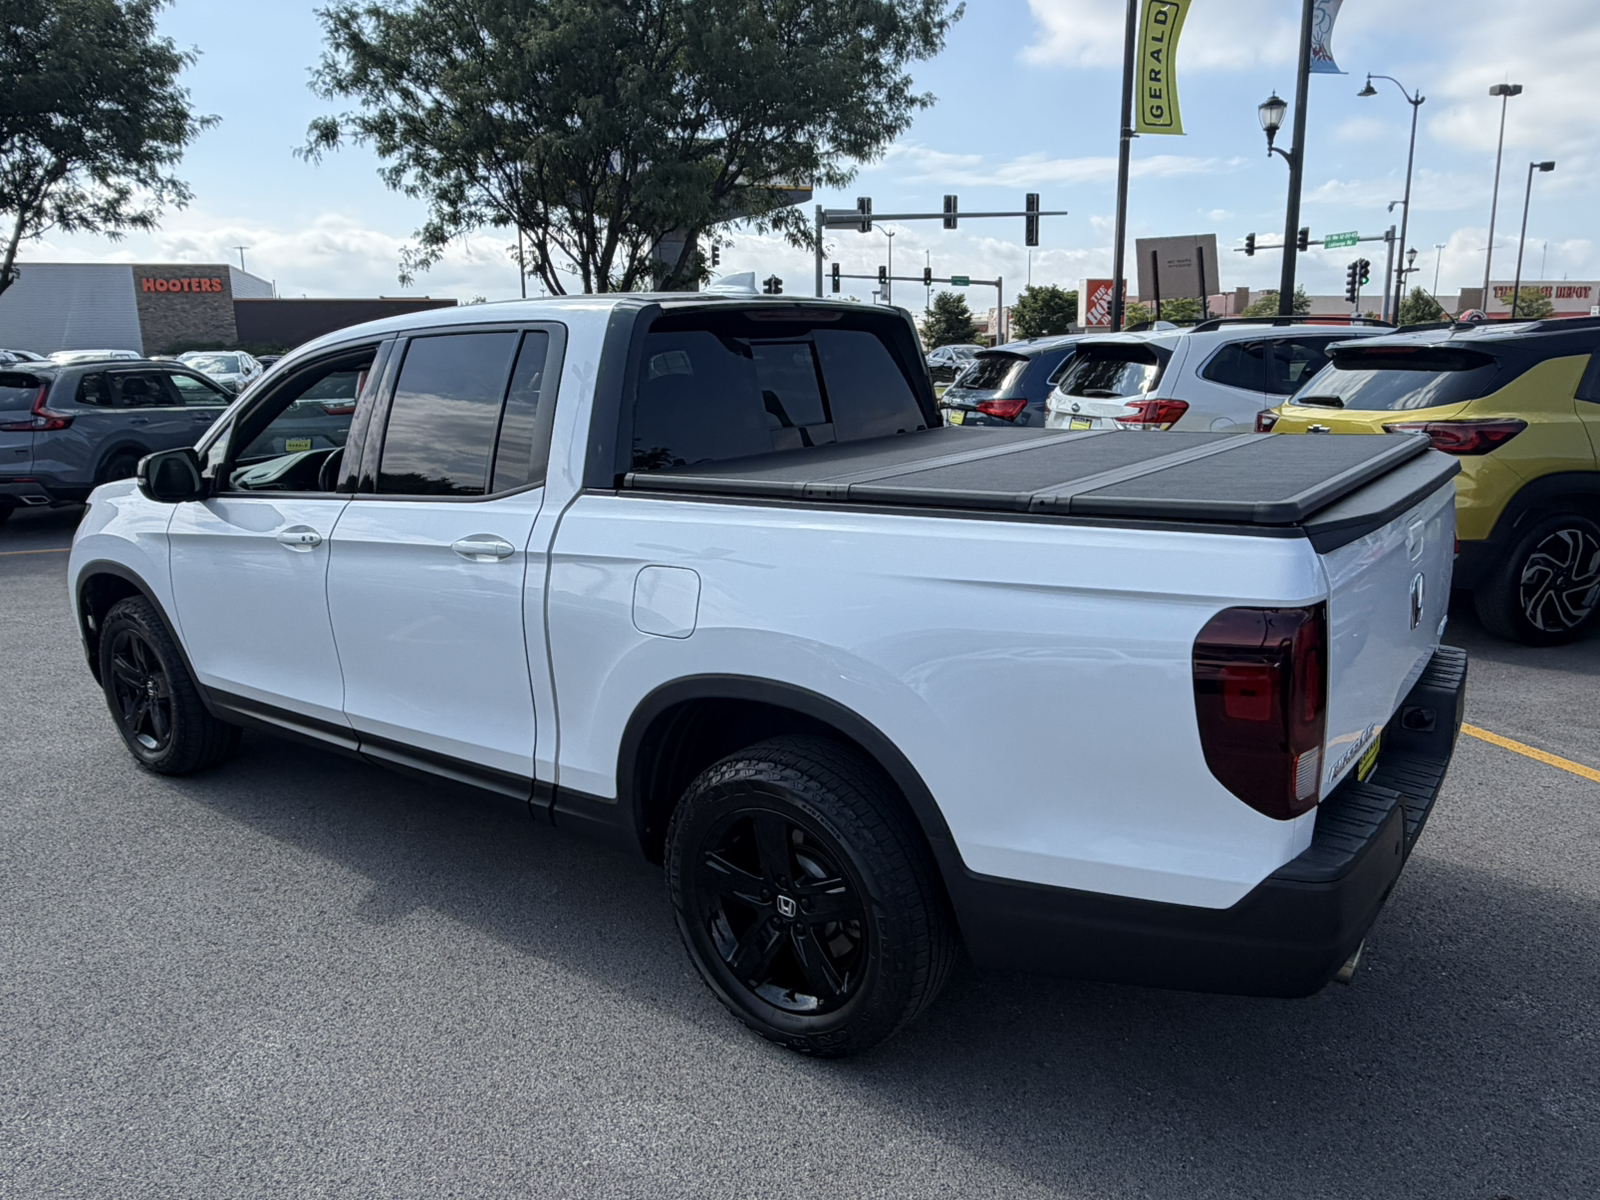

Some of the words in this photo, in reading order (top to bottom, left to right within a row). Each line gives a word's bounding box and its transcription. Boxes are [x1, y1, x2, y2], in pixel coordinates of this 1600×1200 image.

[1149, 9, 1169, 119] GERALD
[142, 277, 222, 293] HOOTERS
[1090, 284, 1107, 303] THE
[1555, 286, 1592, 298] DEPOT
